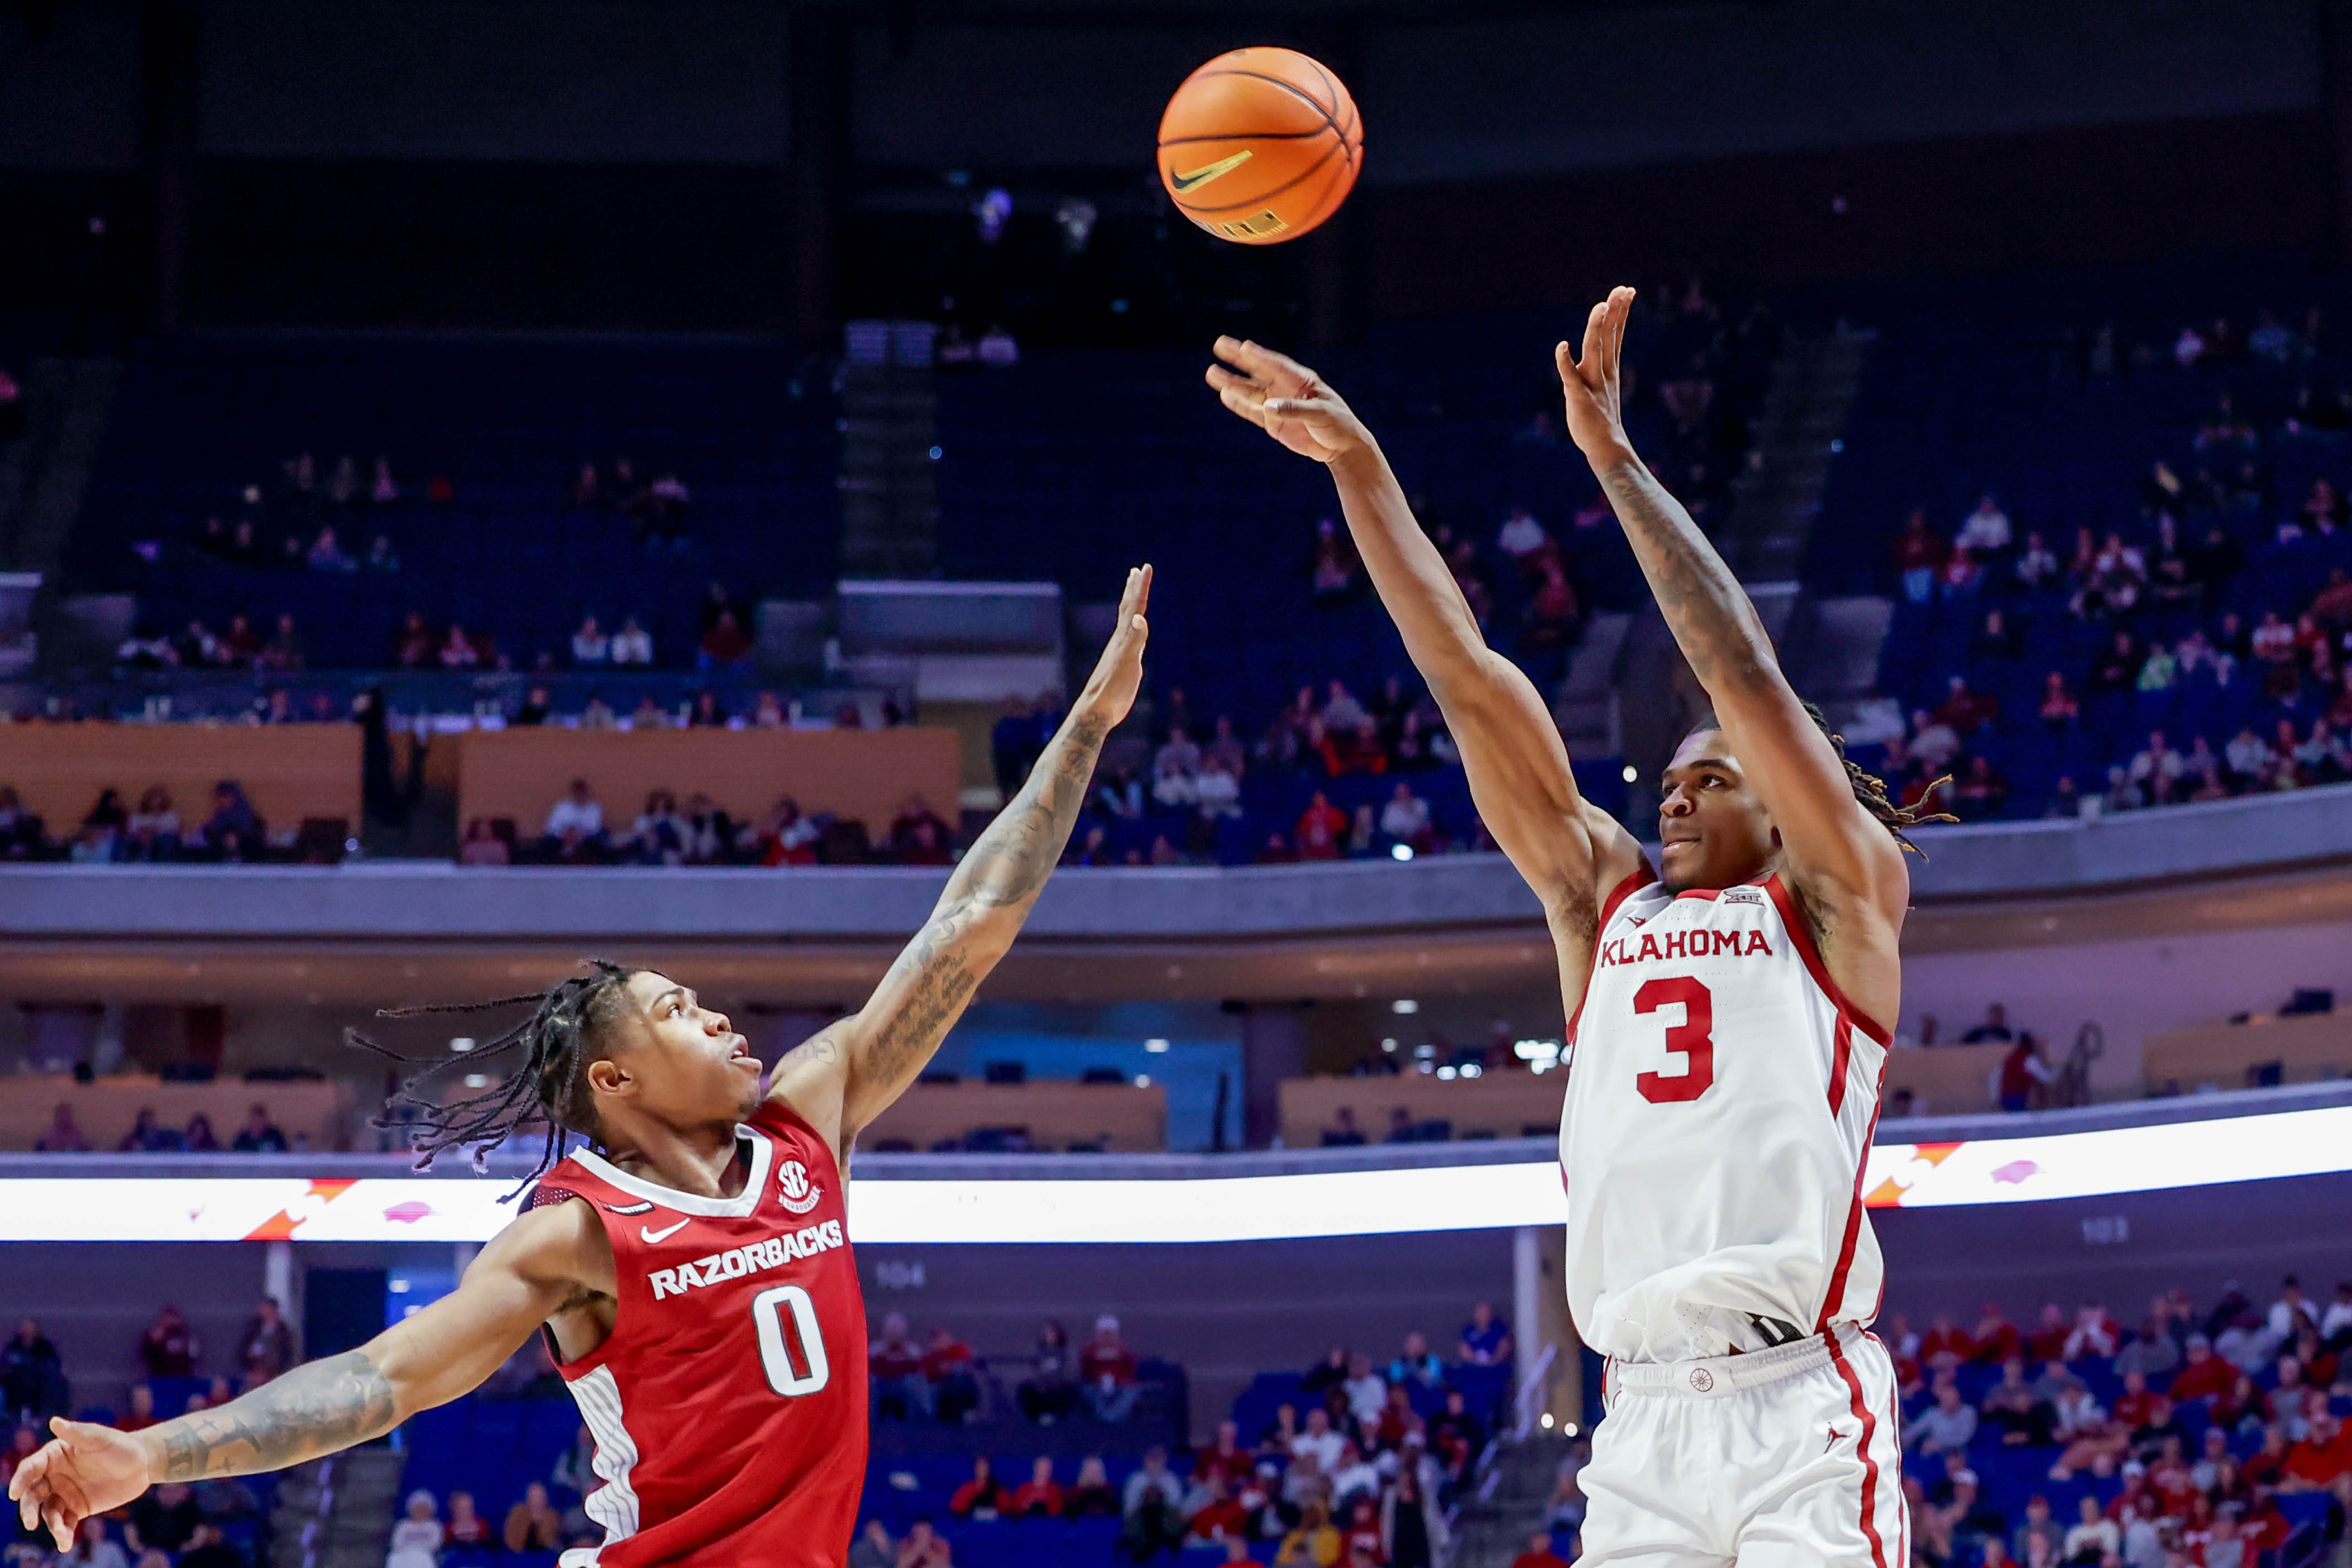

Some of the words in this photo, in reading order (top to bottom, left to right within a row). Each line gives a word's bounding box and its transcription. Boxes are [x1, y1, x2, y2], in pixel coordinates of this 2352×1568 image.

[1633, 976, 1714, 1103] 3
[778, 1160, 809, 1199] SEC
[647, 1219, 844, 1300] RAZORBACKS
[752, 1284, 830, 1397] 0
